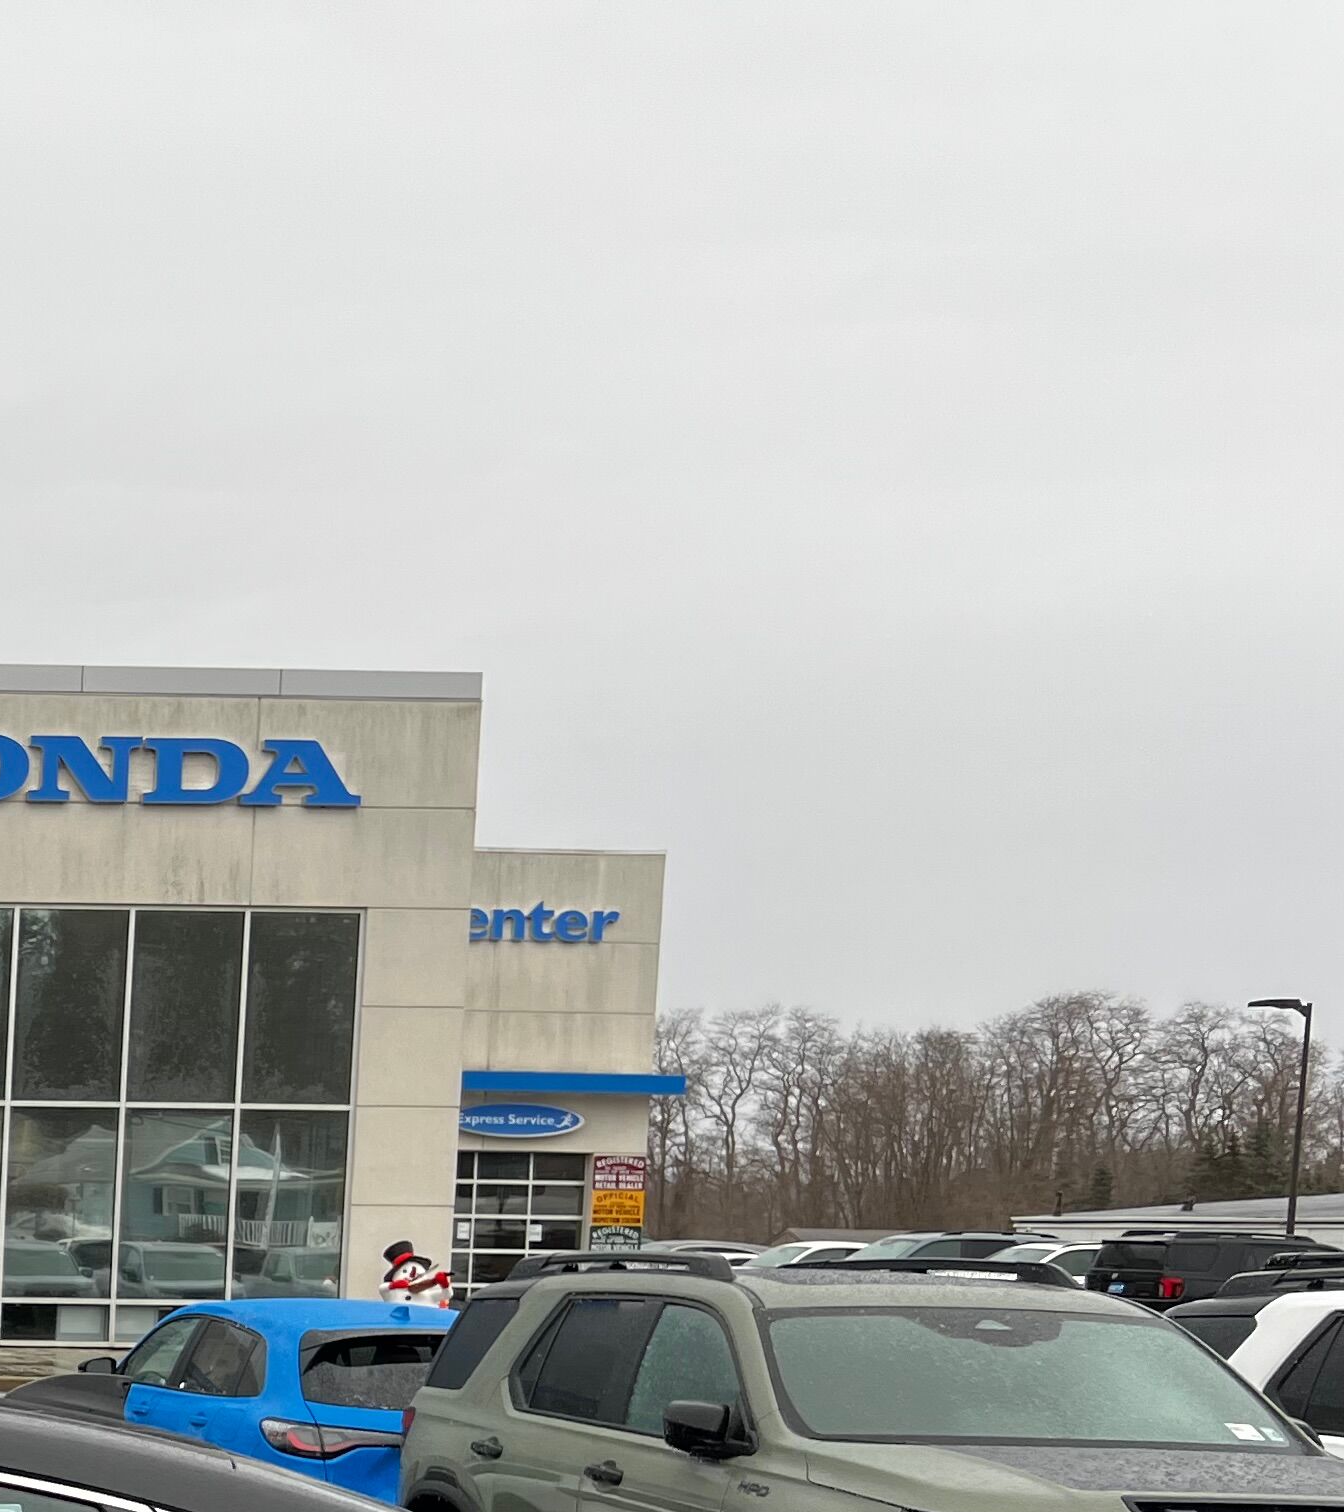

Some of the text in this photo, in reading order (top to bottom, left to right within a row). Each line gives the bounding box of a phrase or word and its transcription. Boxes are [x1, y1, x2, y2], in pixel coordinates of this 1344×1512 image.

[459, 1112, 555, 1127] Express Service
[596, 1192, 640, 1203] OFFICIAL
